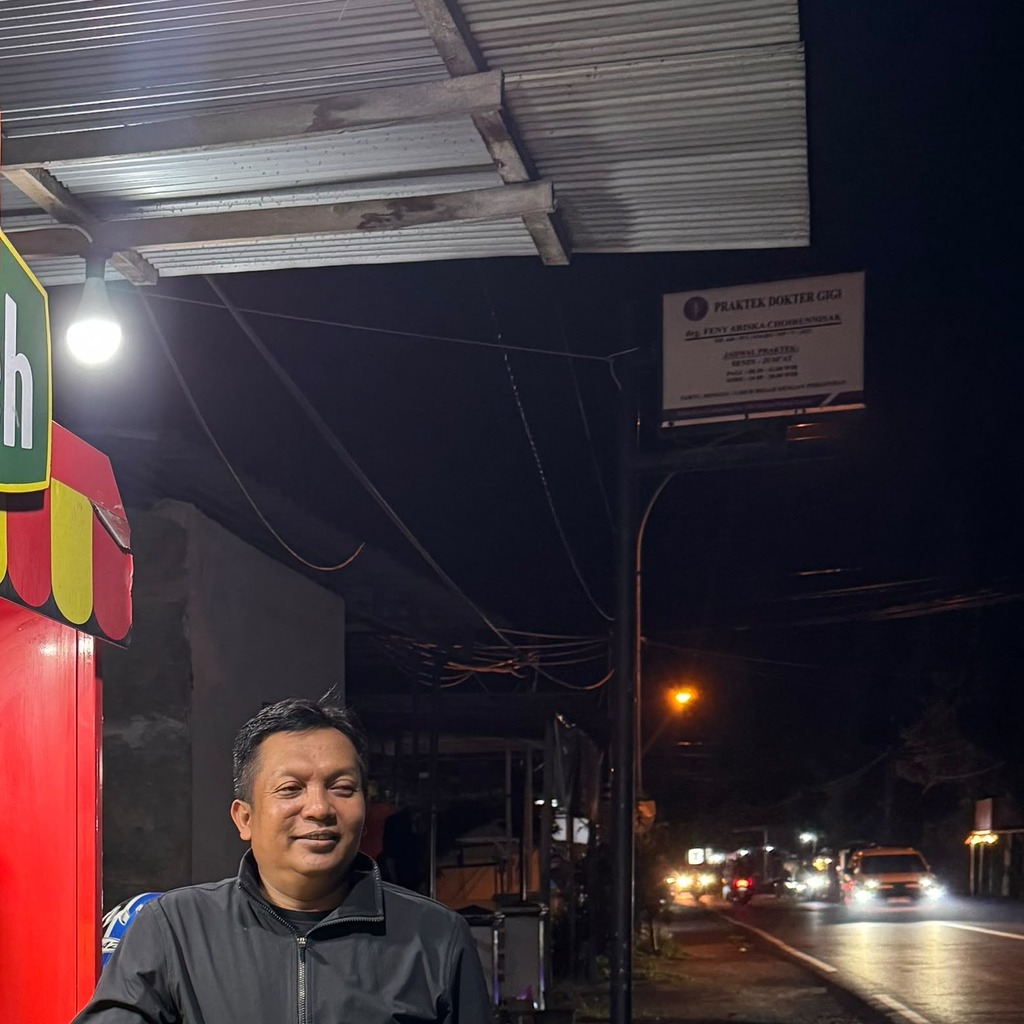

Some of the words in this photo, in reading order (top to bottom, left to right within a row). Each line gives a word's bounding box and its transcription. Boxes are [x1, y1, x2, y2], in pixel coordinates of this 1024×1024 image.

[714, 297, 766, 312] PRAKTEK
[768, 292, 814, 306] DOKTER
[816, 289, 842, 301] GIGI
[704, 327, 728, 336] FENY
